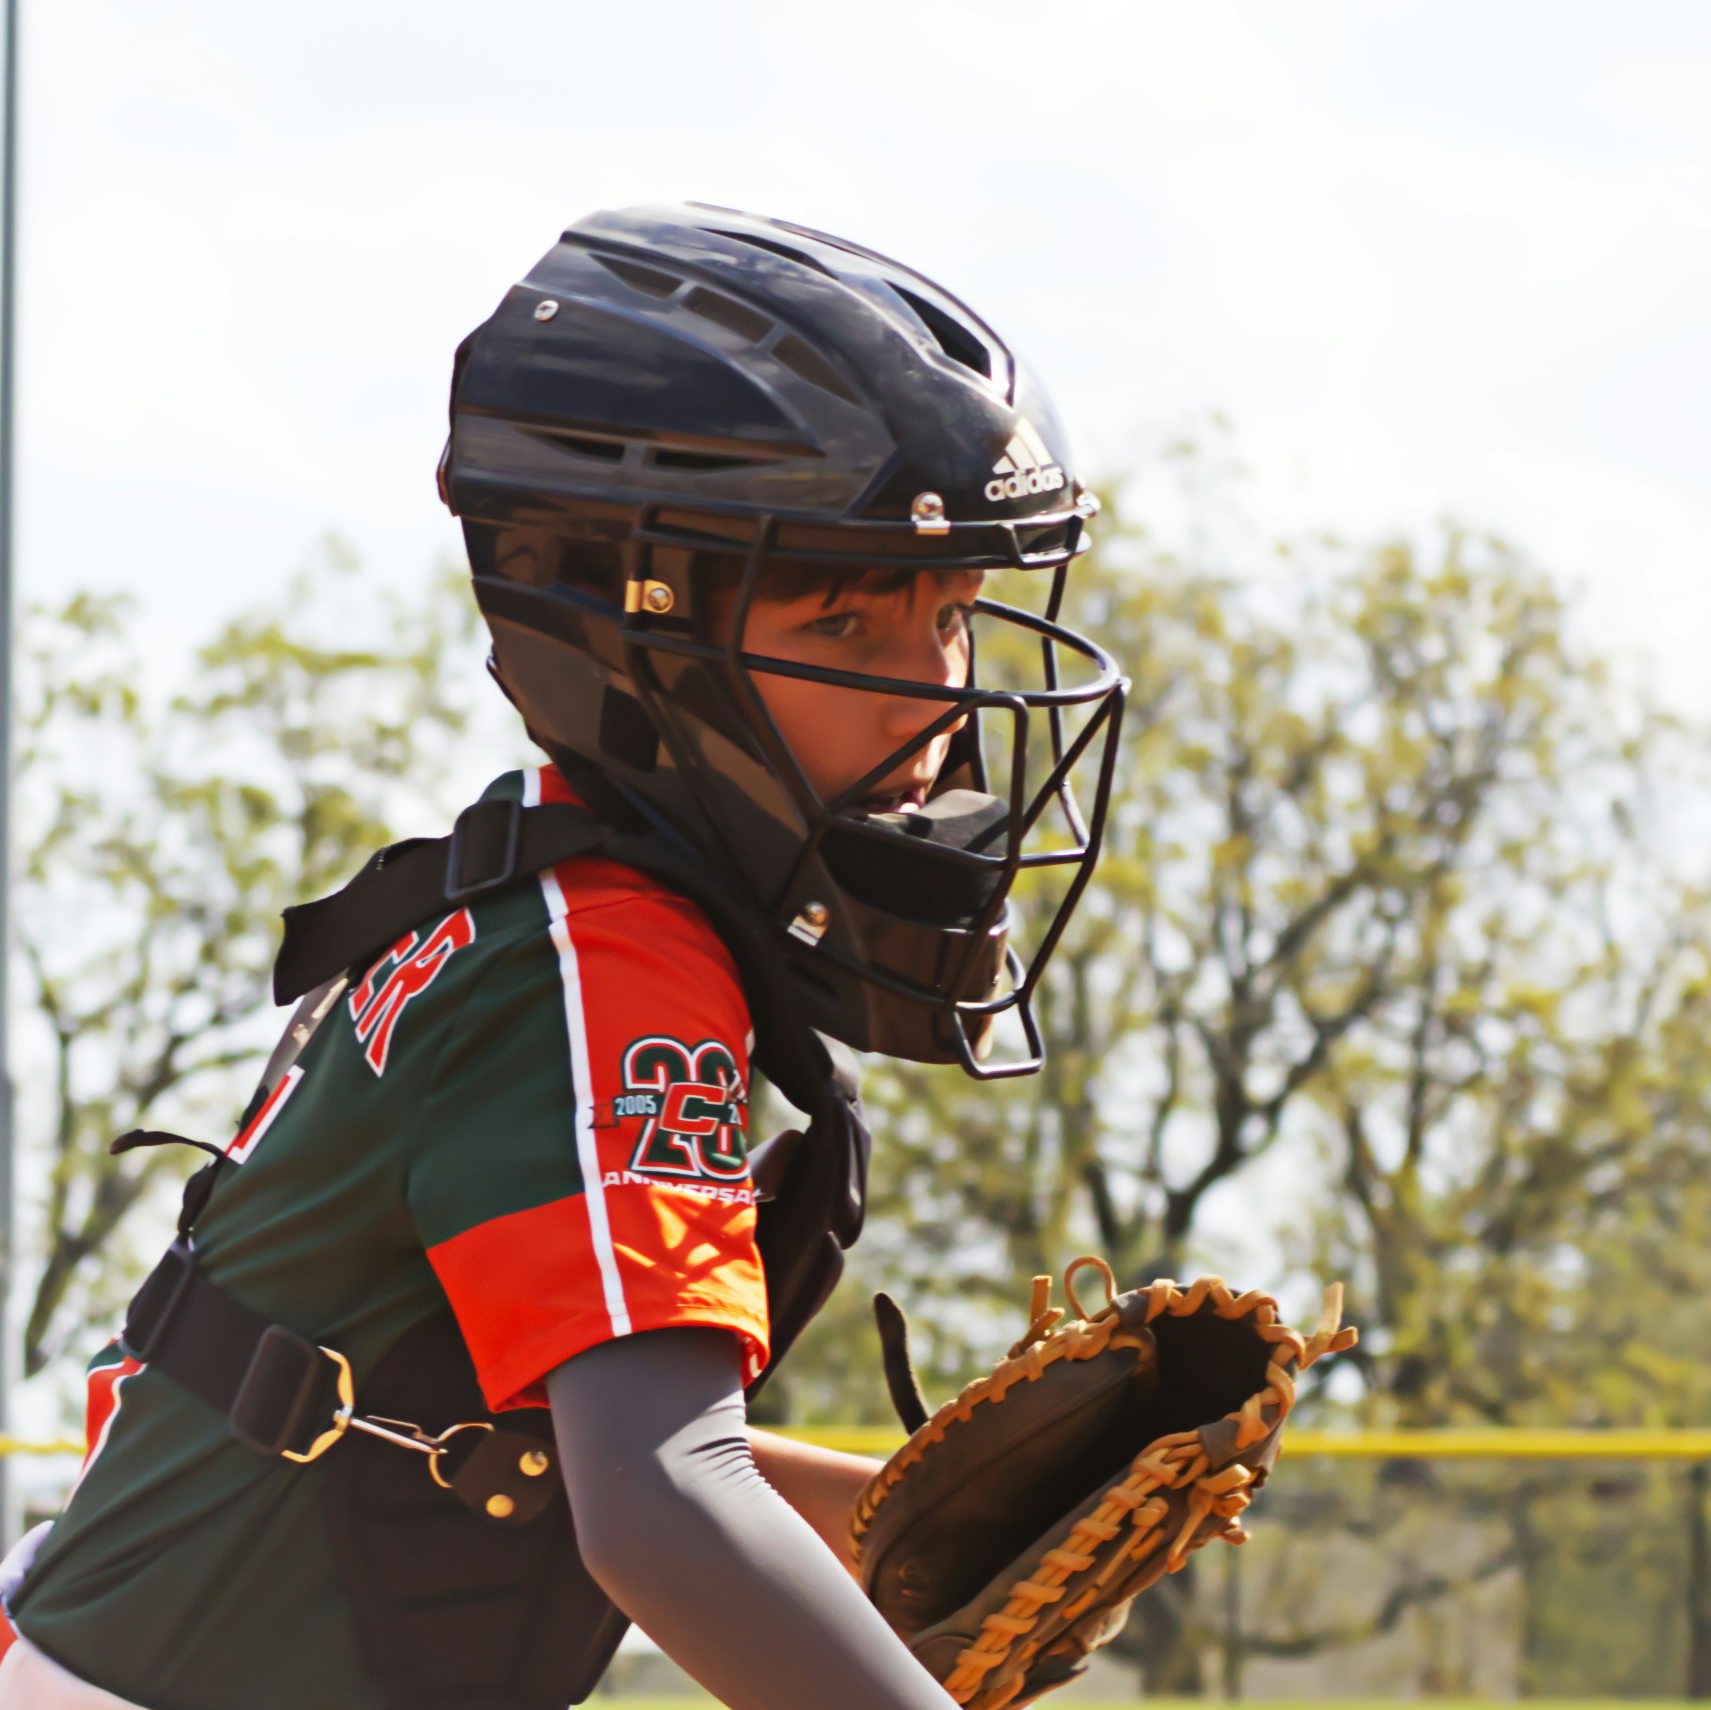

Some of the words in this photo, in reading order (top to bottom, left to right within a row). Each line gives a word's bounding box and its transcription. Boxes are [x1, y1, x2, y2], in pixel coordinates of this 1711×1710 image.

[983, 464, 1065, 502] adidas
[614, 1094, 657, 1116] 2005
[658, 1081, 728, 1136] C
